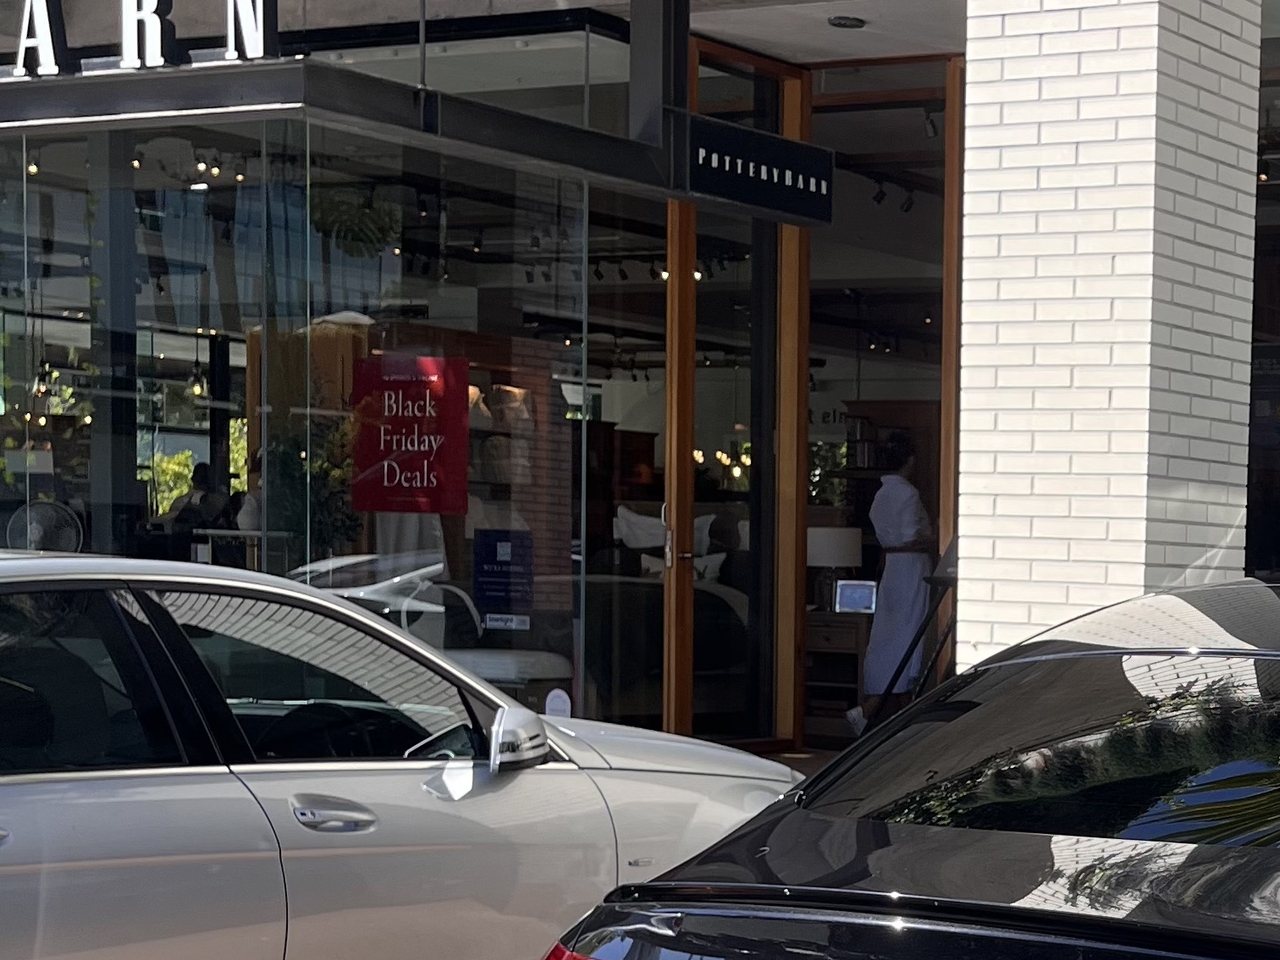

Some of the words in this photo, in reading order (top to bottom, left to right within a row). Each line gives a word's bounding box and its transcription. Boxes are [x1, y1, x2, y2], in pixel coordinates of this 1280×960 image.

[384, 388, 437, 417] Black
[380, 423, 445, 461] Friday
[383, 459, 438, 488] Deals
